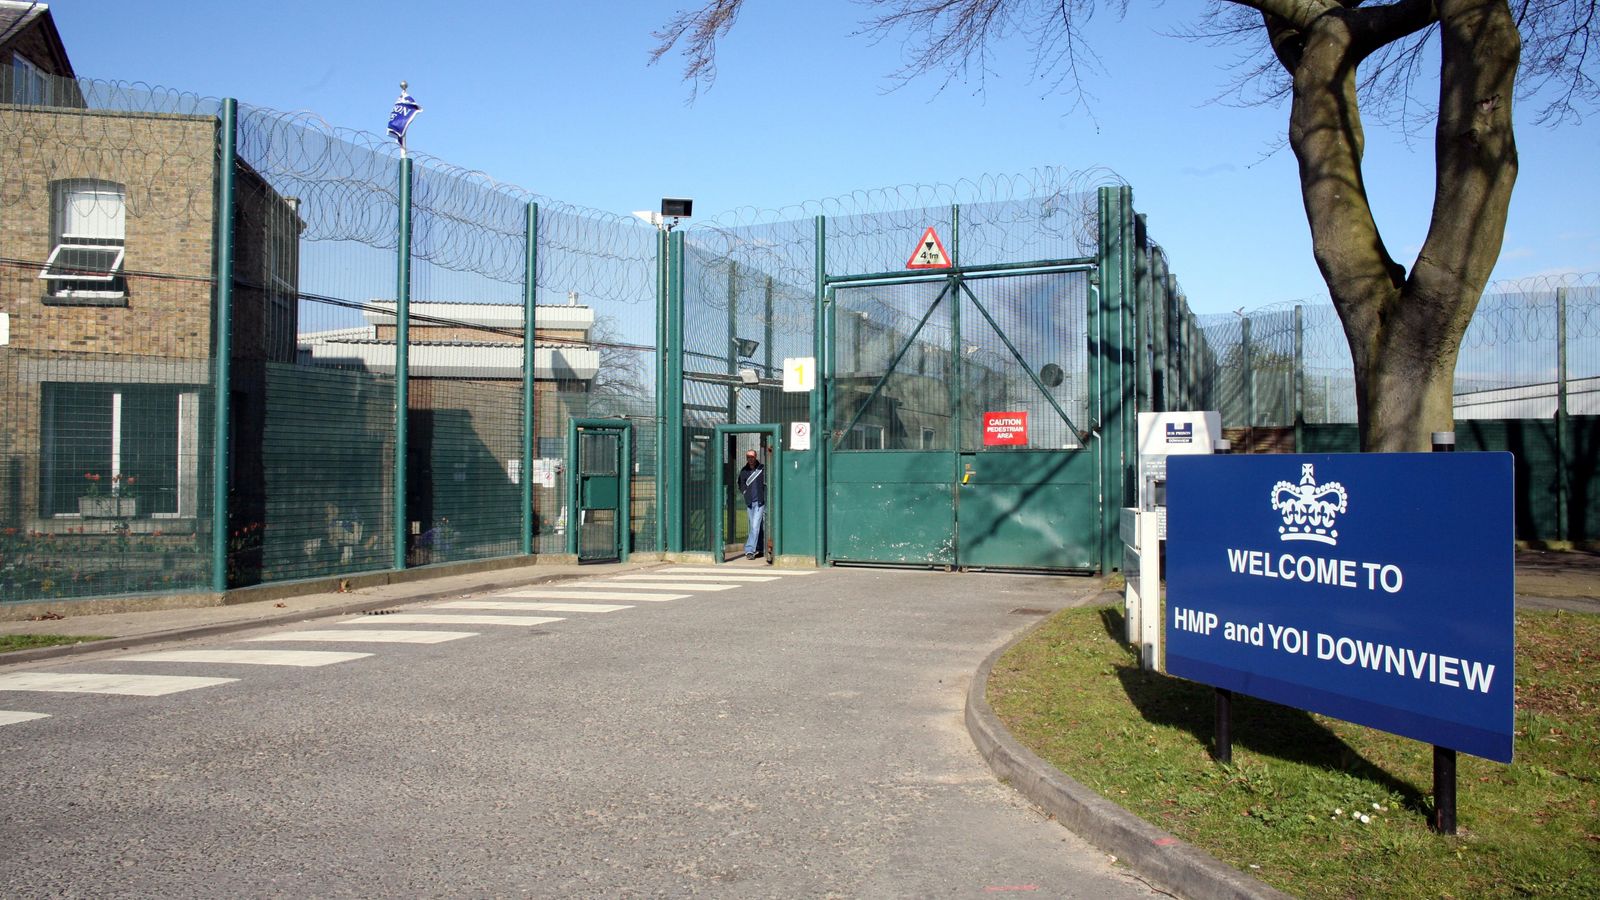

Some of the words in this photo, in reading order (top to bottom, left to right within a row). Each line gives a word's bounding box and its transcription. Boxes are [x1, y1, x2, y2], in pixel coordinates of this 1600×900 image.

[794, 363, 804, 385] 1
[989, 418, 1022, 426] CAUTION
[1227, 548, 1357, 588] WELCOME
[1362, 562, 1403, 594] TO
[1174, 606, 1219, 636] HMP
[1223, 621, 1264, 647] and
[1267, 623, 1308, 656] YOI
[1317, 632, 1496, 694] DOWNVIEW
